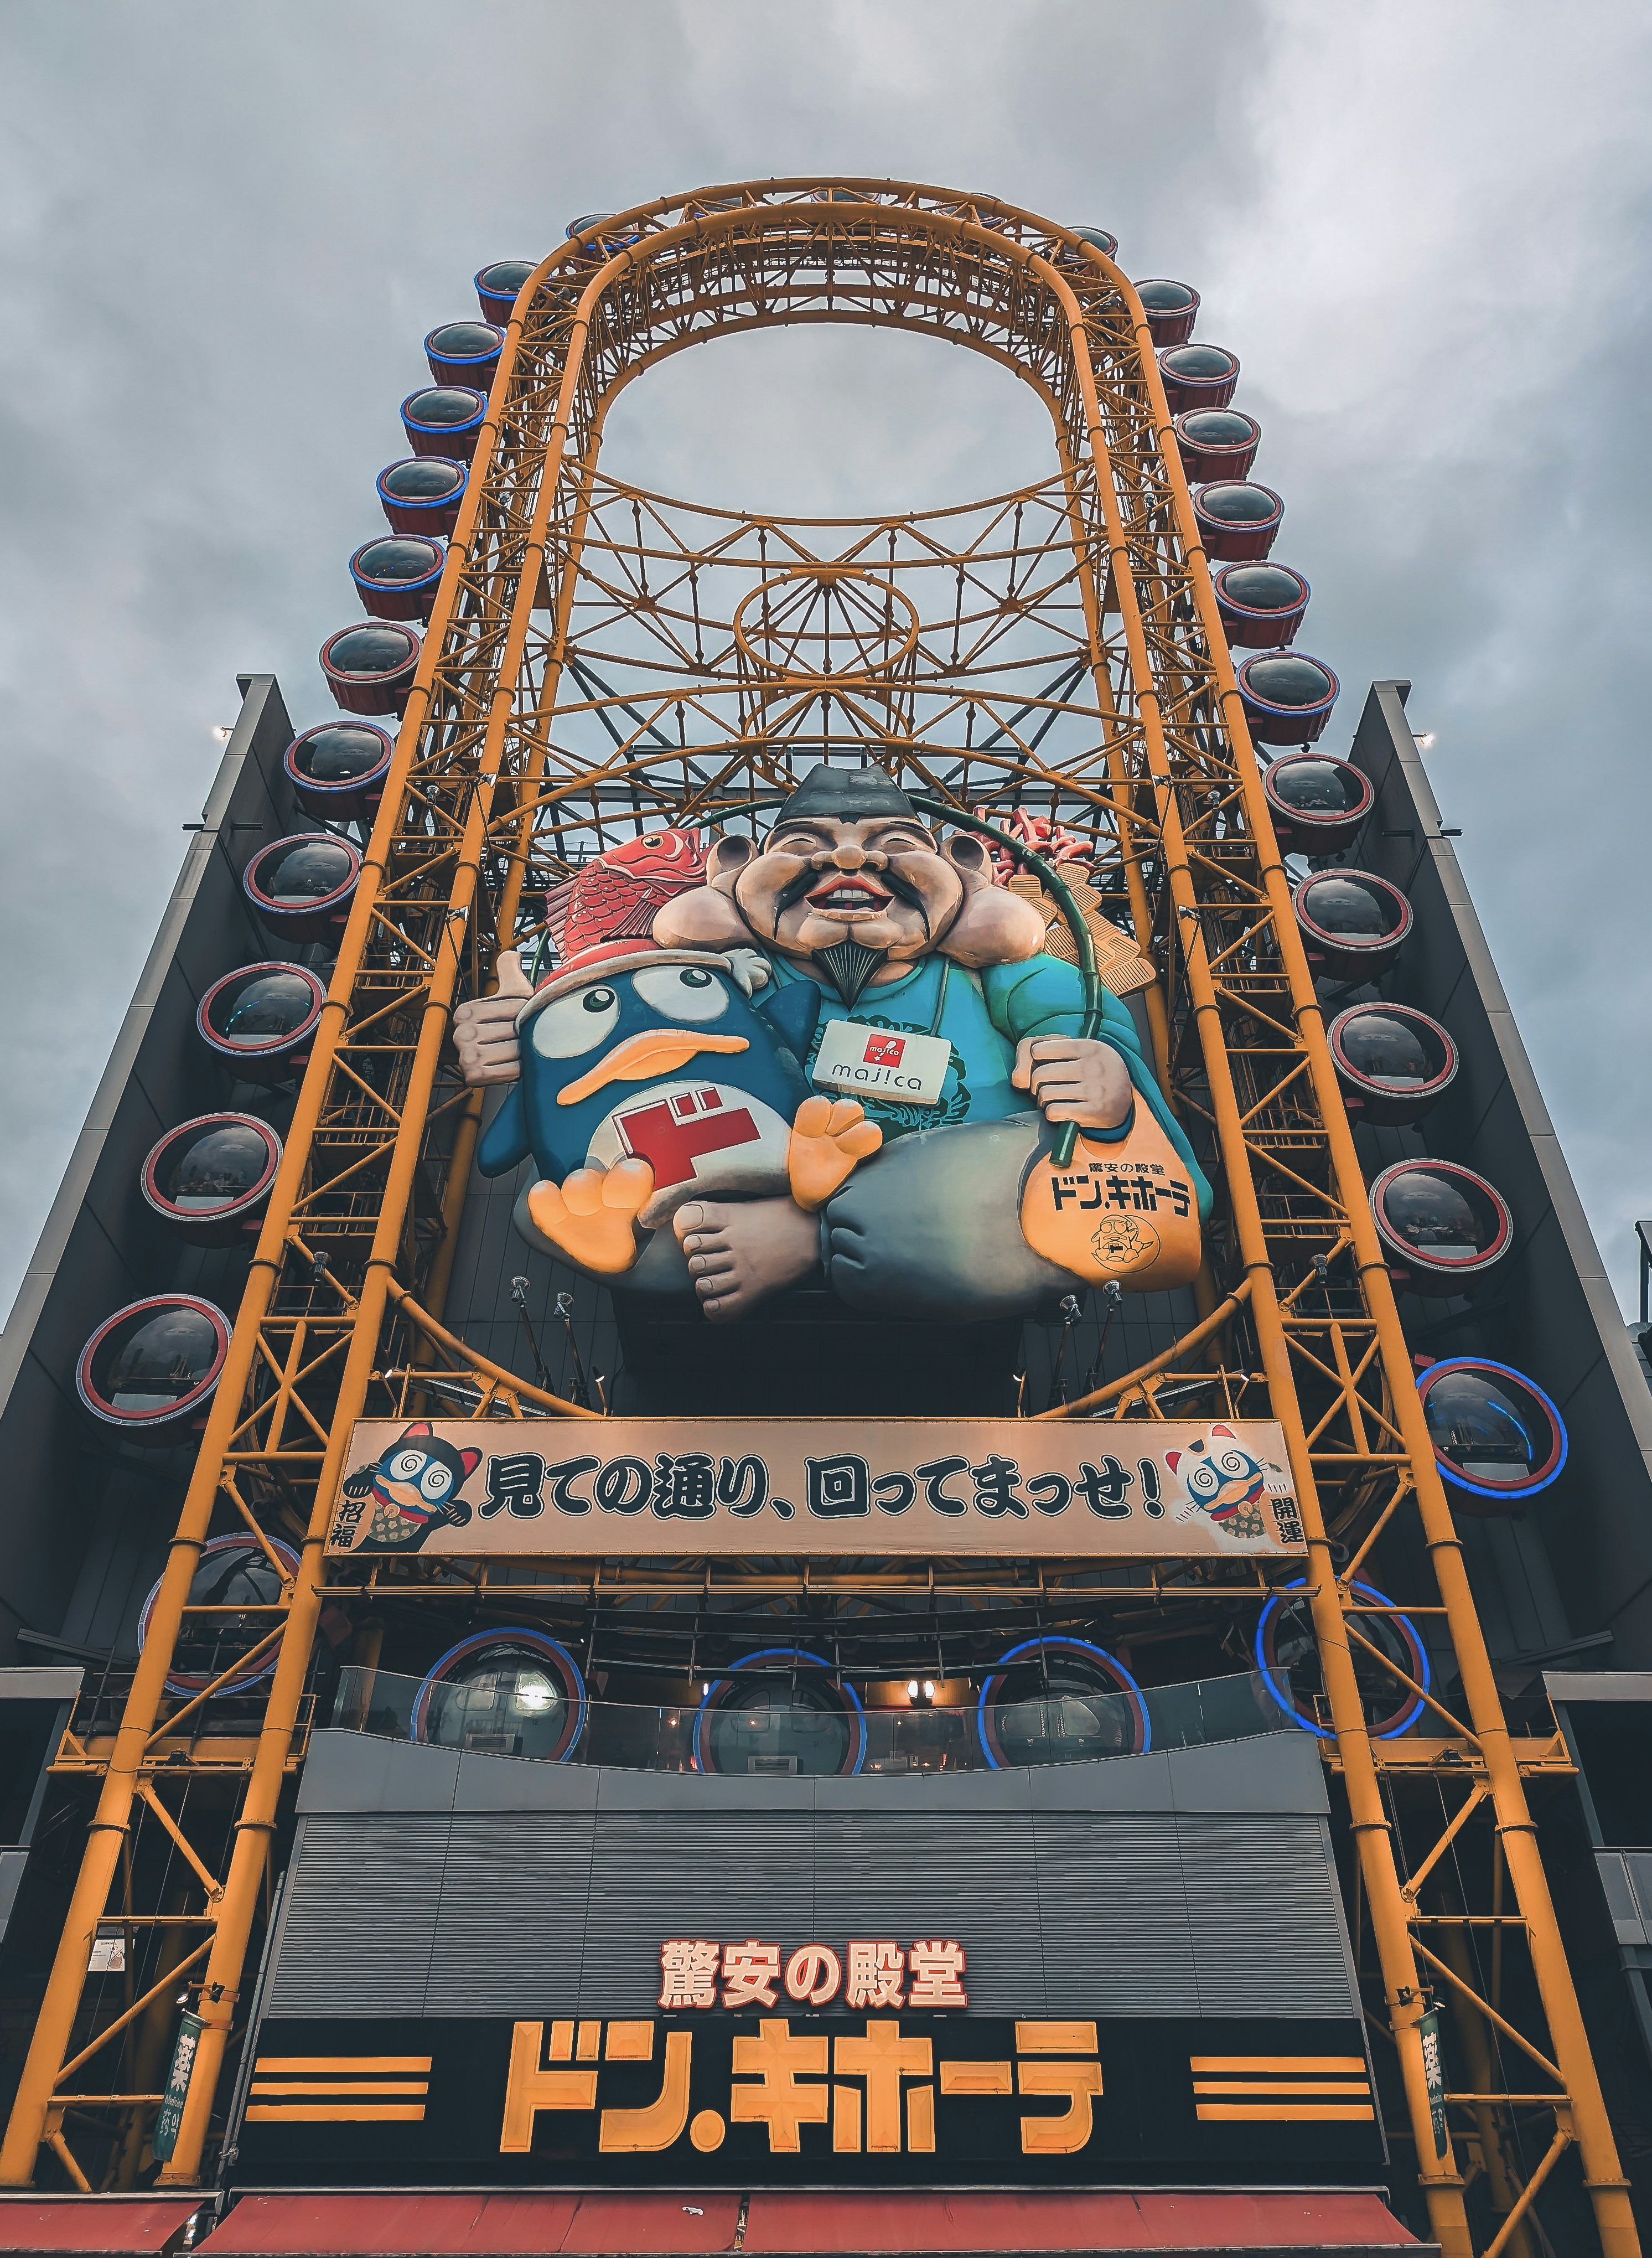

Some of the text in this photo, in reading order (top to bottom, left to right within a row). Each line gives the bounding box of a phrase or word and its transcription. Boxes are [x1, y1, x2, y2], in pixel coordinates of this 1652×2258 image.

[1088, 1162, 1166, 1176] 驚安の殿堂
[330, 1499, 366, 1548] 招福
[1270, 1496, 1304, 1544] 開運
[658, 1939, 969, 2009] 驚安の殿堂
[170, 2033, 196, 2093] 薬
[1422, 2032, 1442, 2090] 薬
